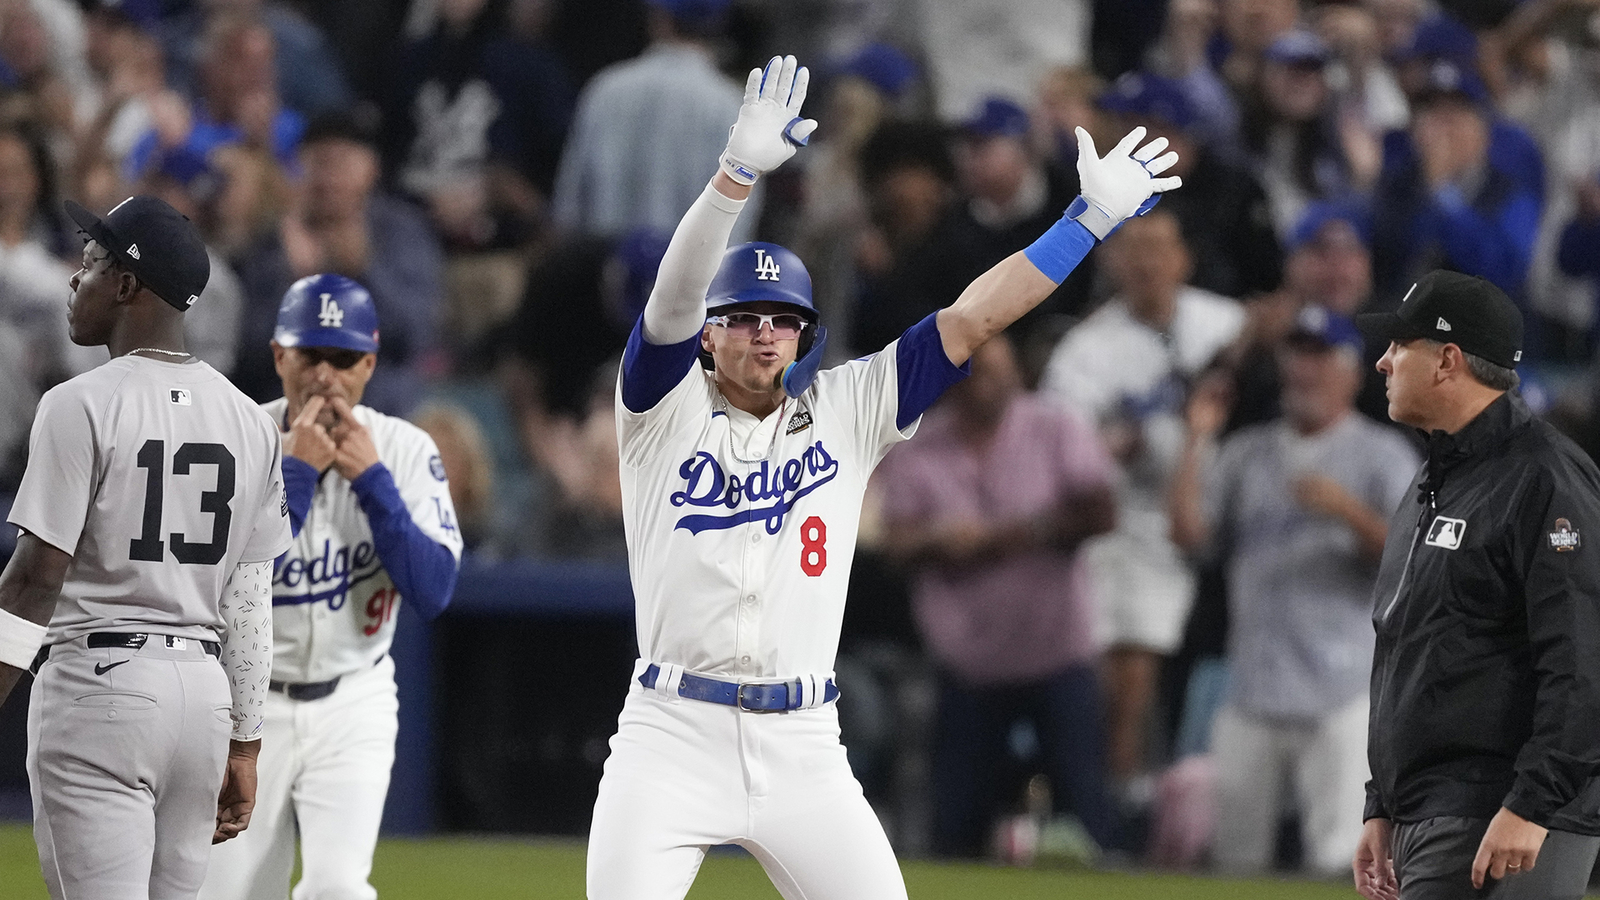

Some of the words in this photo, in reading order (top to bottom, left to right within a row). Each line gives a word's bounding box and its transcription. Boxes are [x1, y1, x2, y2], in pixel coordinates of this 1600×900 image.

[754, 249, 780, 281] LA
[317, 292, 345, 328] LA
[129, 439, 236, 565] 13
[670, 440, 838, 536] Dodgers
[272, 539, 378, 611] odge
[800, 515, 827, 577] 8
